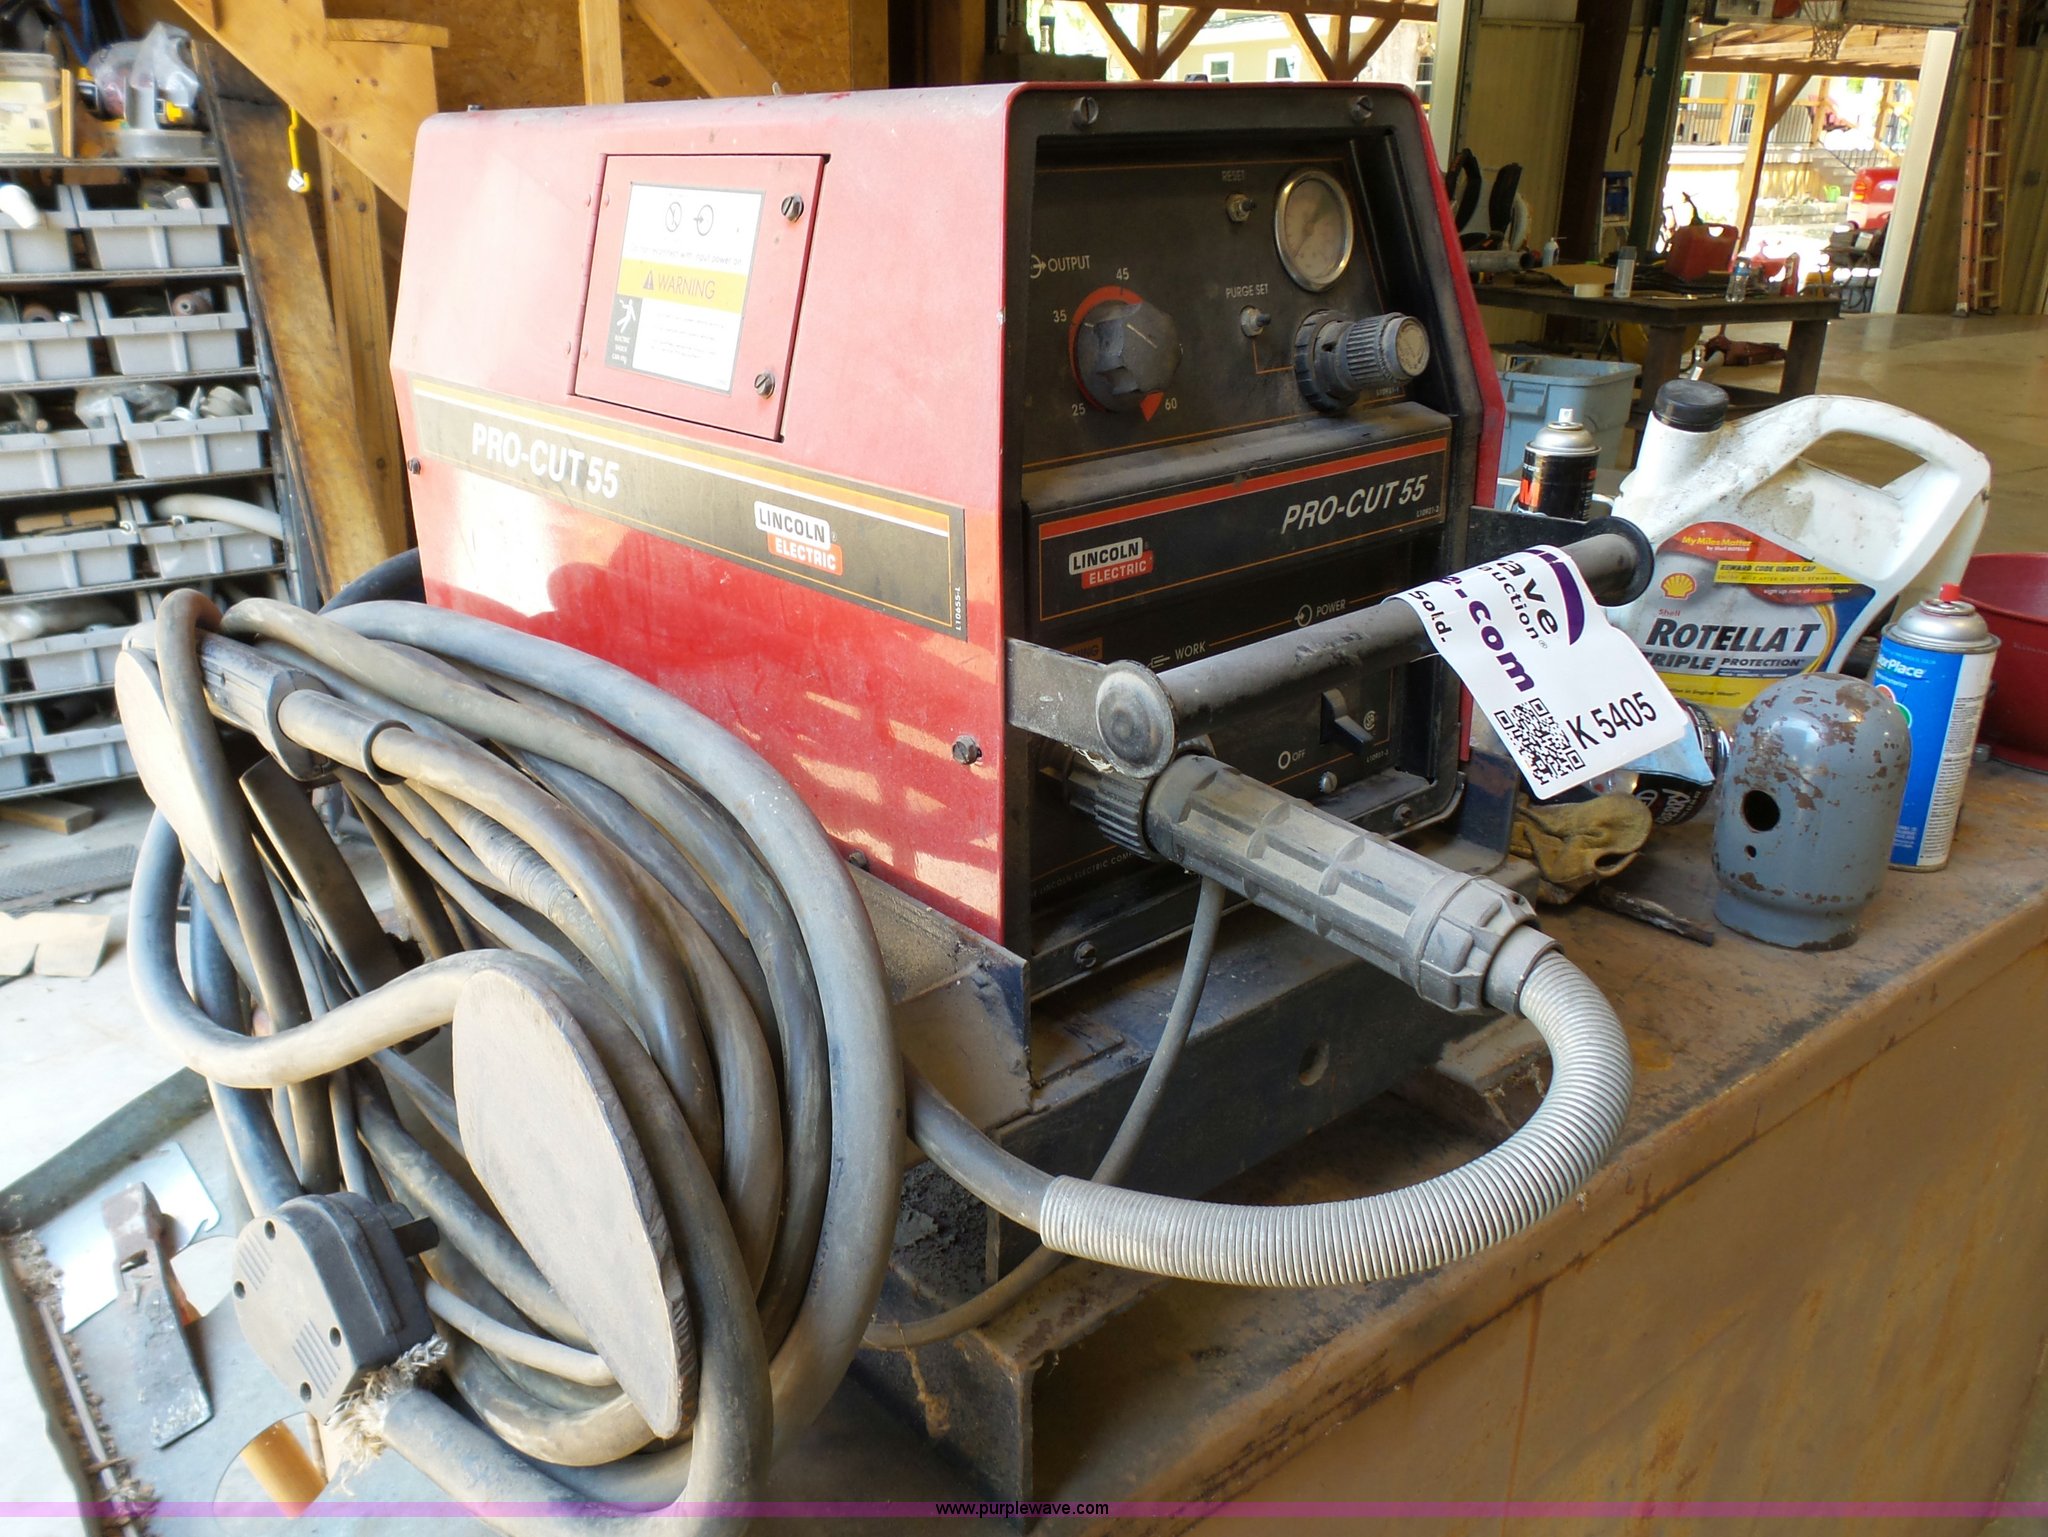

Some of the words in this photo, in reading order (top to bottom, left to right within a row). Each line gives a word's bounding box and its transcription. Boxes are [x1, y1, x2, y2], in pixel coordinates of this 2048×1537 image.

[1047, 254, 1090, 272] OUTPUT
[1115, 267, 1129, 281] 45
[658, 272, 716, 299] WARNING
[1226, 285, 1254, 299] PURGE
[1255, 283, 1269, 296] SET
[1053, 309, 1067, 323] 35
[1071, 403, 1086, 417] 25
[1164, 397, 1178, 411] 60
[471, 422, 585, 486] PRO-CUT
[586, 456, 620, 499] 55
[1280, 480, 1400, 535] PRO-CUT
[1398, 474, 1429, 505] 55
[759, 508, 825, 543] LINCOLN
[774, 537, 836, 571] ELECTRIC
[1073, 542, 1139, 571] LINCOLN
[1089, 560, 1147, 585] ELECTRIC
[1316, 599, 1346, 617] POWER
[1497, 560, 1558, 635] ave
[1409, 590, 1452, 643] Sold.
[1658, 608, 1681, 617] Shell
[1646, 617, 1790, 653] ROTELLA
[1793, 623, 1822, 653] T
[1174, 641, 1206, 661] WORK
[1720, 657, 1801, 668] PROTECTION
[1565, 714, 1600, 749] K
[1590, 691, 1657, 738] 5405
[1291, 748, 1306, 761] OFF
